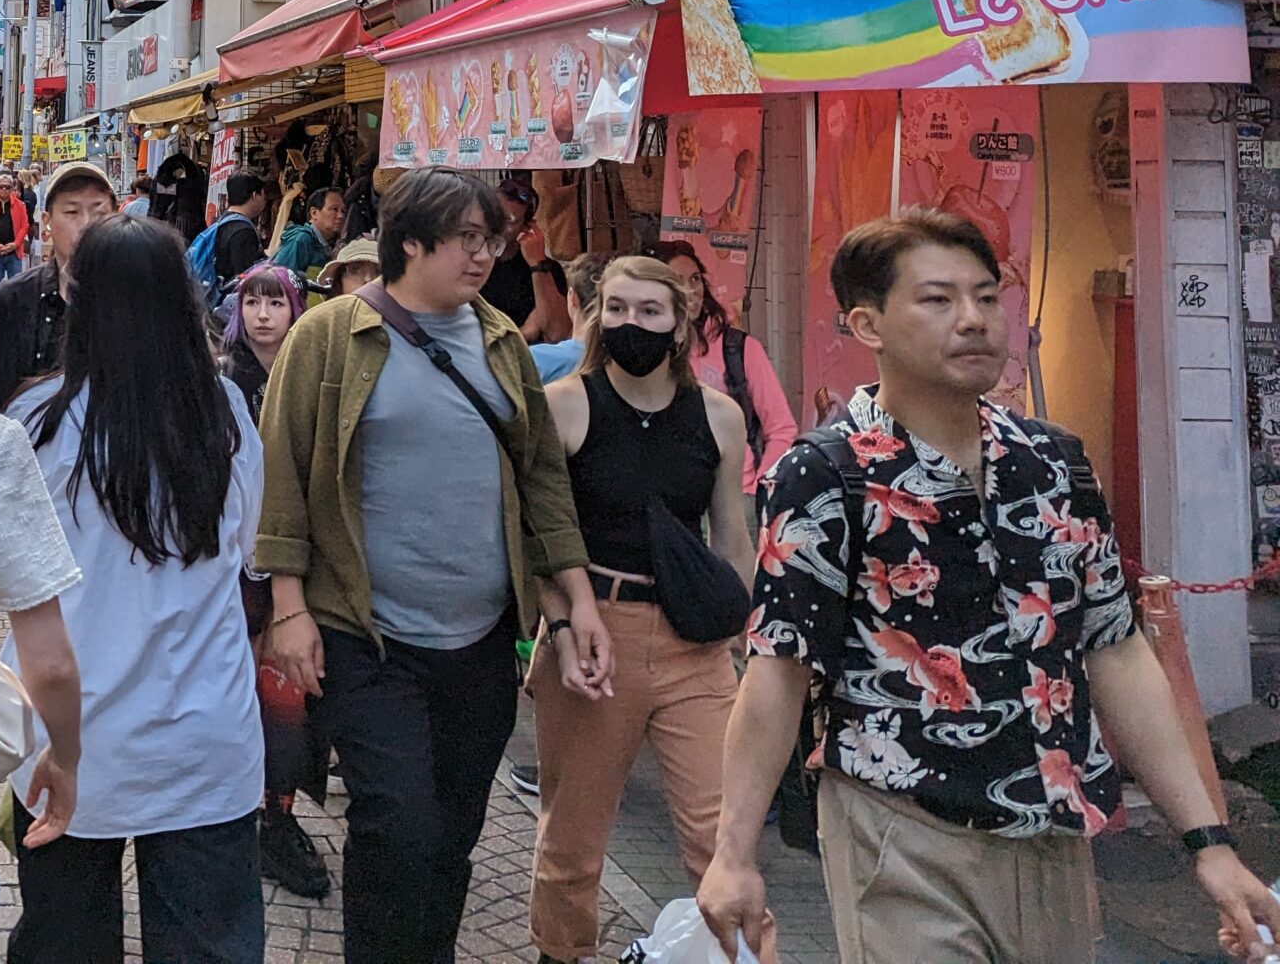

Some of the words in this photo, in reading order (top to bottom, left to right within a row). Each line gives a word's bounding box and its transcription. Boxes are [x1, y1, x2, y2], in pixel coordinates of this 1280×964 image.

[86, 46, 96, 82] JEANS
[977, 133, 1019, 151] りんご飴
